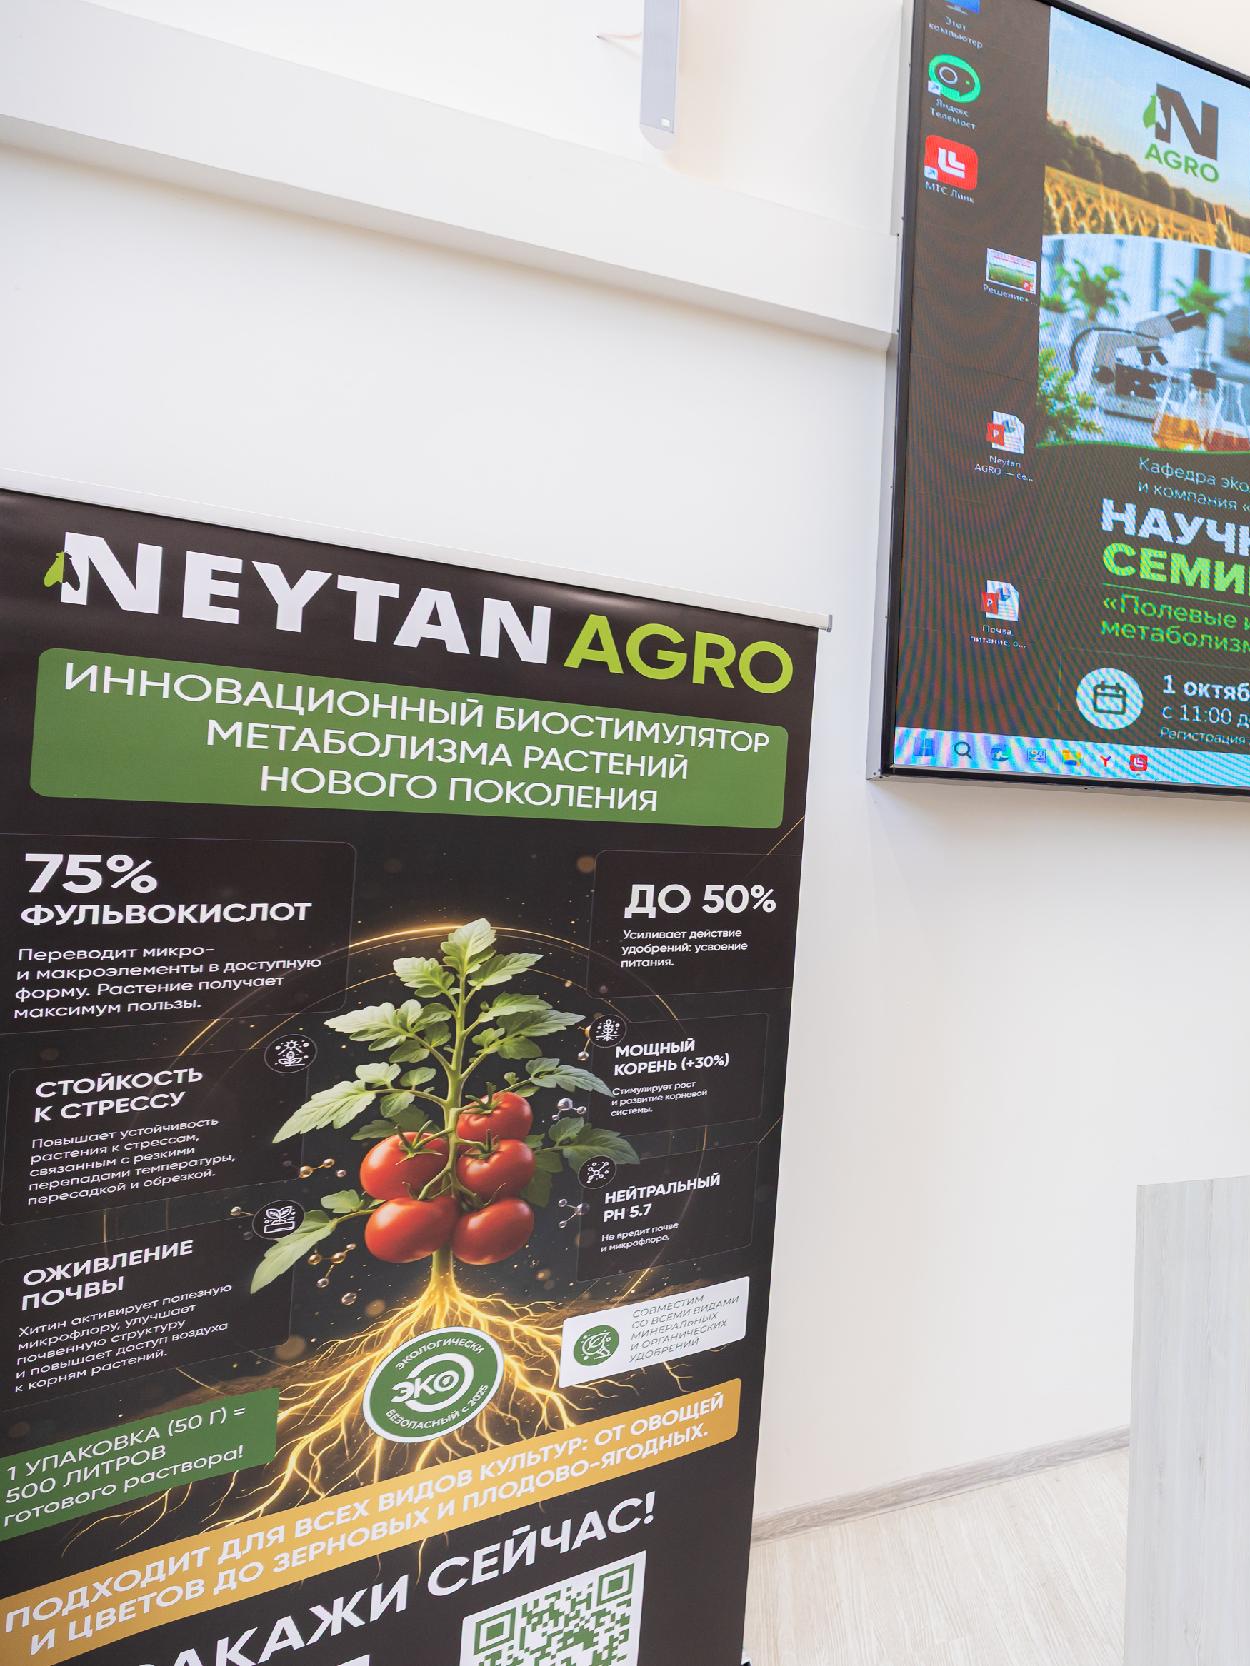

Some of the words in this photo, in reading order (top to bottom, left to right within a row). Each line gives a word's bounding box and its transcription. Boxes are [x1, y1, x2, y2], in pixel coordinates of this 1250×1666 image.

[1144, 143, 1219, 183] AGRO
[1138, 457, 1216, 485] Кафедра
[1138, 481, 1149, 493] и
[1154, 484, 1237, 512] компания
[60, 531, 553, 665] NEYTAN
[563, 614, 794, 695] AGRO
[1104, 593, 1237, 629] «Полевые
[1163, 675, 1175, 694] 1
[64, 661, 485, 728] ИННОВАЦИОННЫЙ
[495, 706, 771, 755] БИОСТИМУЛЯТОР
[1162, 705, 1173, 719] с
[1179, 704, 1232, 725] 11:00
[207, 719, 512, 769] МЕТАБОЛИЗМА
[524, 744, 689, 781] РАСТЕНИЙ
[1160, 727, 1246, 746] Регистрация
[260, 765, 439, 802] НОВОГО
[449, 777, 658, 813] ПОКОЛЕНИЯ
[25, 853, 158, 894] 75%
[20, 902, 312, 926] ФУЛЬВОКИСЛОТ
[624, 884, 692, 918] ДО
[702, 884, 777, 914] 50%
[621, 942, 692, 955] удобрений:
[695, 942, 748, 954] усвоение
[623, 930, 687, 939] Усиливает
[689, 928, 742, 940] действие
[16, 969, 30, 981] и
[36, 963, 204, 983] макроэлементы
[209, 962, 220, 972] в
[224, 957, 322, 974] доступную
[18, 948, 136, 964] Переводит
[143, 945, 215, 961] микро-
[620, 958, 674, 968] питания.
[15, 985, 91, 1003] форму.
[98, 981, 194, 997] Растение
[199, 975, 285, 992] получает
[14, 1003, 121, 1020] максимум
[127, 998, 202, 1013] пользы.
[614, 1060, 677, 1076] КОРЕНЬ
[681, 1053, 730, 1071] (+30%)
[615, 1038, 695, 1059] МОЩНЫЙ
[35, 1067, 204, 1099] СТОЙКОСТЬ
[34, 1106, 52, 1123] К
[61, 1090, 186, 1120] СТРЕССУ
[30, 1147, 108, 1165] растения
[111, 1143, 120, 1153] к
[124, 1134, 200, 1153] стрессам,
[31, 1131, 117, 1150] Повышает
[119, 1118, 219, 1140] устойчивость
[28, 1169, 131, 1193] перепадами
[135, 1153, 236, 1178] температуры,
[29, 1159, 117, 1178] связанным
[133, 1147, 195, 1166] резкими
[28, 1182, 127, 1206] пересадкой
[130, 1181, 139, 1191] и
[143, 1169, 216, 1188] обрезкой.
[605, 1172, 721, 1205] НЕЙТРАЛЬНЫЙ
[629, 1203, 652, 1219] 5.7
[23, 1239, 194, 1286] ОЖИВЛЕНИЕ
[21, 1276, 124, 1311] ПОЧВЫ
[633, 1295, 704, 1318] СОВМЕСТИМ
[18, 1320, 67, 1338] Хитин
[71, 1299, 160, 1327] активирует
[162, 1284, 232, 1307] полезную
[18, 1320, 121, 1351] микрофлору,
[125, 1304, 197, 1329] улучшает
[631, 1312, 719, 1341] МИНЕРАЛЬНЫХ
[632, 1320, 648, 1329] СО
[651, 1309, 691, 1325] ВСЕМИ
[693, 1296, 740, 1315] ВИДАМИ
[15, 1370, 26, 1380] и
[30, 1351, 112, 1377] повышает
[115, 1337, 168, 1358] доступ
[172, 1322, 229, 1343] воздуха
[16, 1340, 106, 1366] почвенную
[110, 1319, 186, 1345] структуру
[641, 1320, 727, 1349] ОРГАНИЧЕСКИХ
[15, 1383, 23, 1393] к
[28, 1368, 87, 1393] корням
[91, 1348, 168, 1378] растений.
[395, 1338, 484, 1370] ЭКОЛОГИЧЕСКИ
[390, 1370, 460, 1403] ЭКО
[386, 1409, 460, 1430] БЕЗОПАСНЫЙ
[7, 1466, 16, 1480] 1
[25, 1426, 160, 1477] УПАКОВКА
[168, 1413, 203, 1438] (50
[209, 1406, 227, 1427] Г)
[3, 1484, 117, 1527] готового
[123, 1444, 244, 1494] раствора!
[6, 1478, 56, 1504] 500
[63, 1444, 166, 1488] ЛИТРОВ
[4, 1545, 210, 1633] ПОДХОДИТ
[217, 1524, 285, 1566] ДЛЯ
[294, 1499, 371, 1539] ВСЕХ
[378, 1466, 472, 1513] ВИДОВ
[480, 1436, 588, 1482] КУЛЬТУР:
[594, 1424, 630, 1447] ОТ
[630, 1391, 724, 1438] ОВОЩЕЙ
[29, 1627, 56, 1656] И
[67, 1577, 205, 1642] ЦВЕТОВ
[213, 1561, 263, 1596] ДО
[272, 1509, 428, 1573] ЗЕРНОВЫХ
[437, 1500, 455, 1520] И
[462, 1425, 709, 1514] ПЛОДОВО-ЯГОДНЫХ.
[427, 1491, 656, 1597] СЕЙЧАС!
